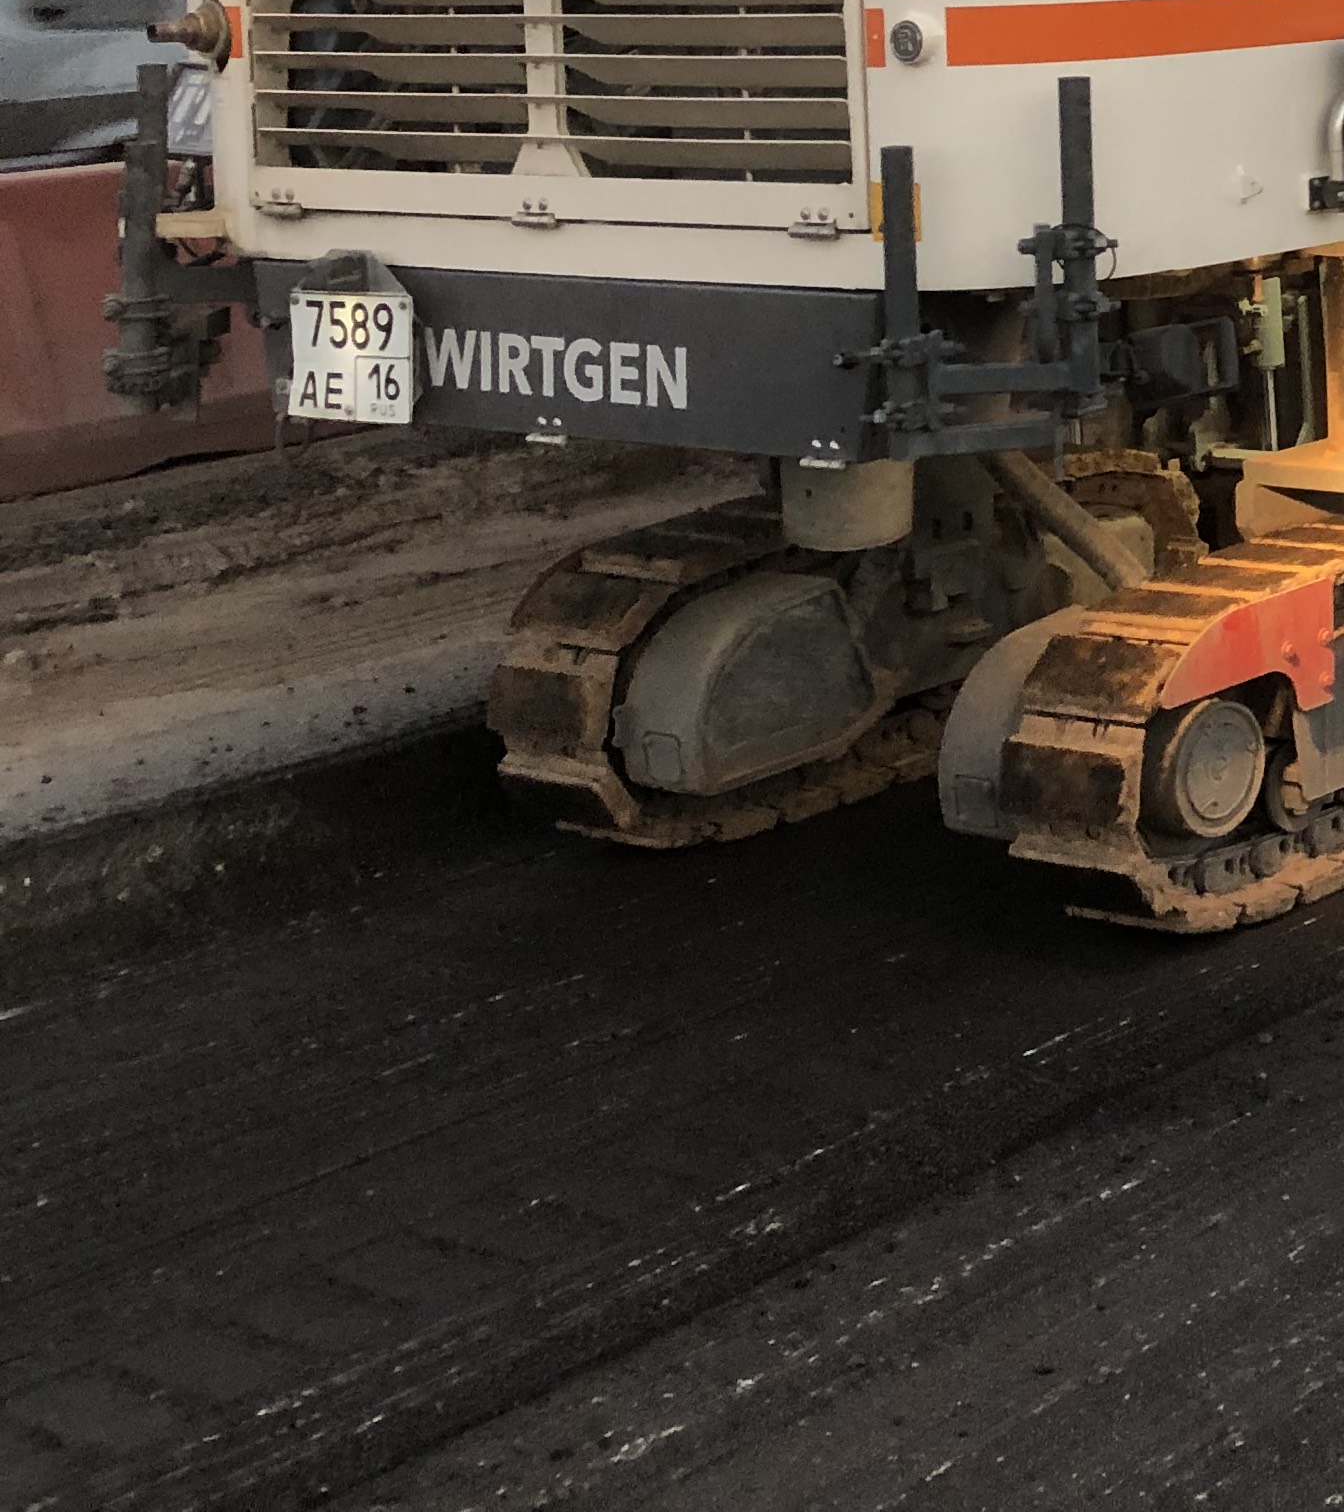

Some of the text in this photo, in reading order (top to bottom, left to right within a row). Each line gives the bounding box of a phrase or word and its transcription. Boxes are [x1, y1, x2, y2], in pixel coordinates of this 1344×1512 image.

[305, 299, 394, 352] 7589
[367, 362, 401, 401] 16
[424, 326, 688, 410] WIRTGEN
